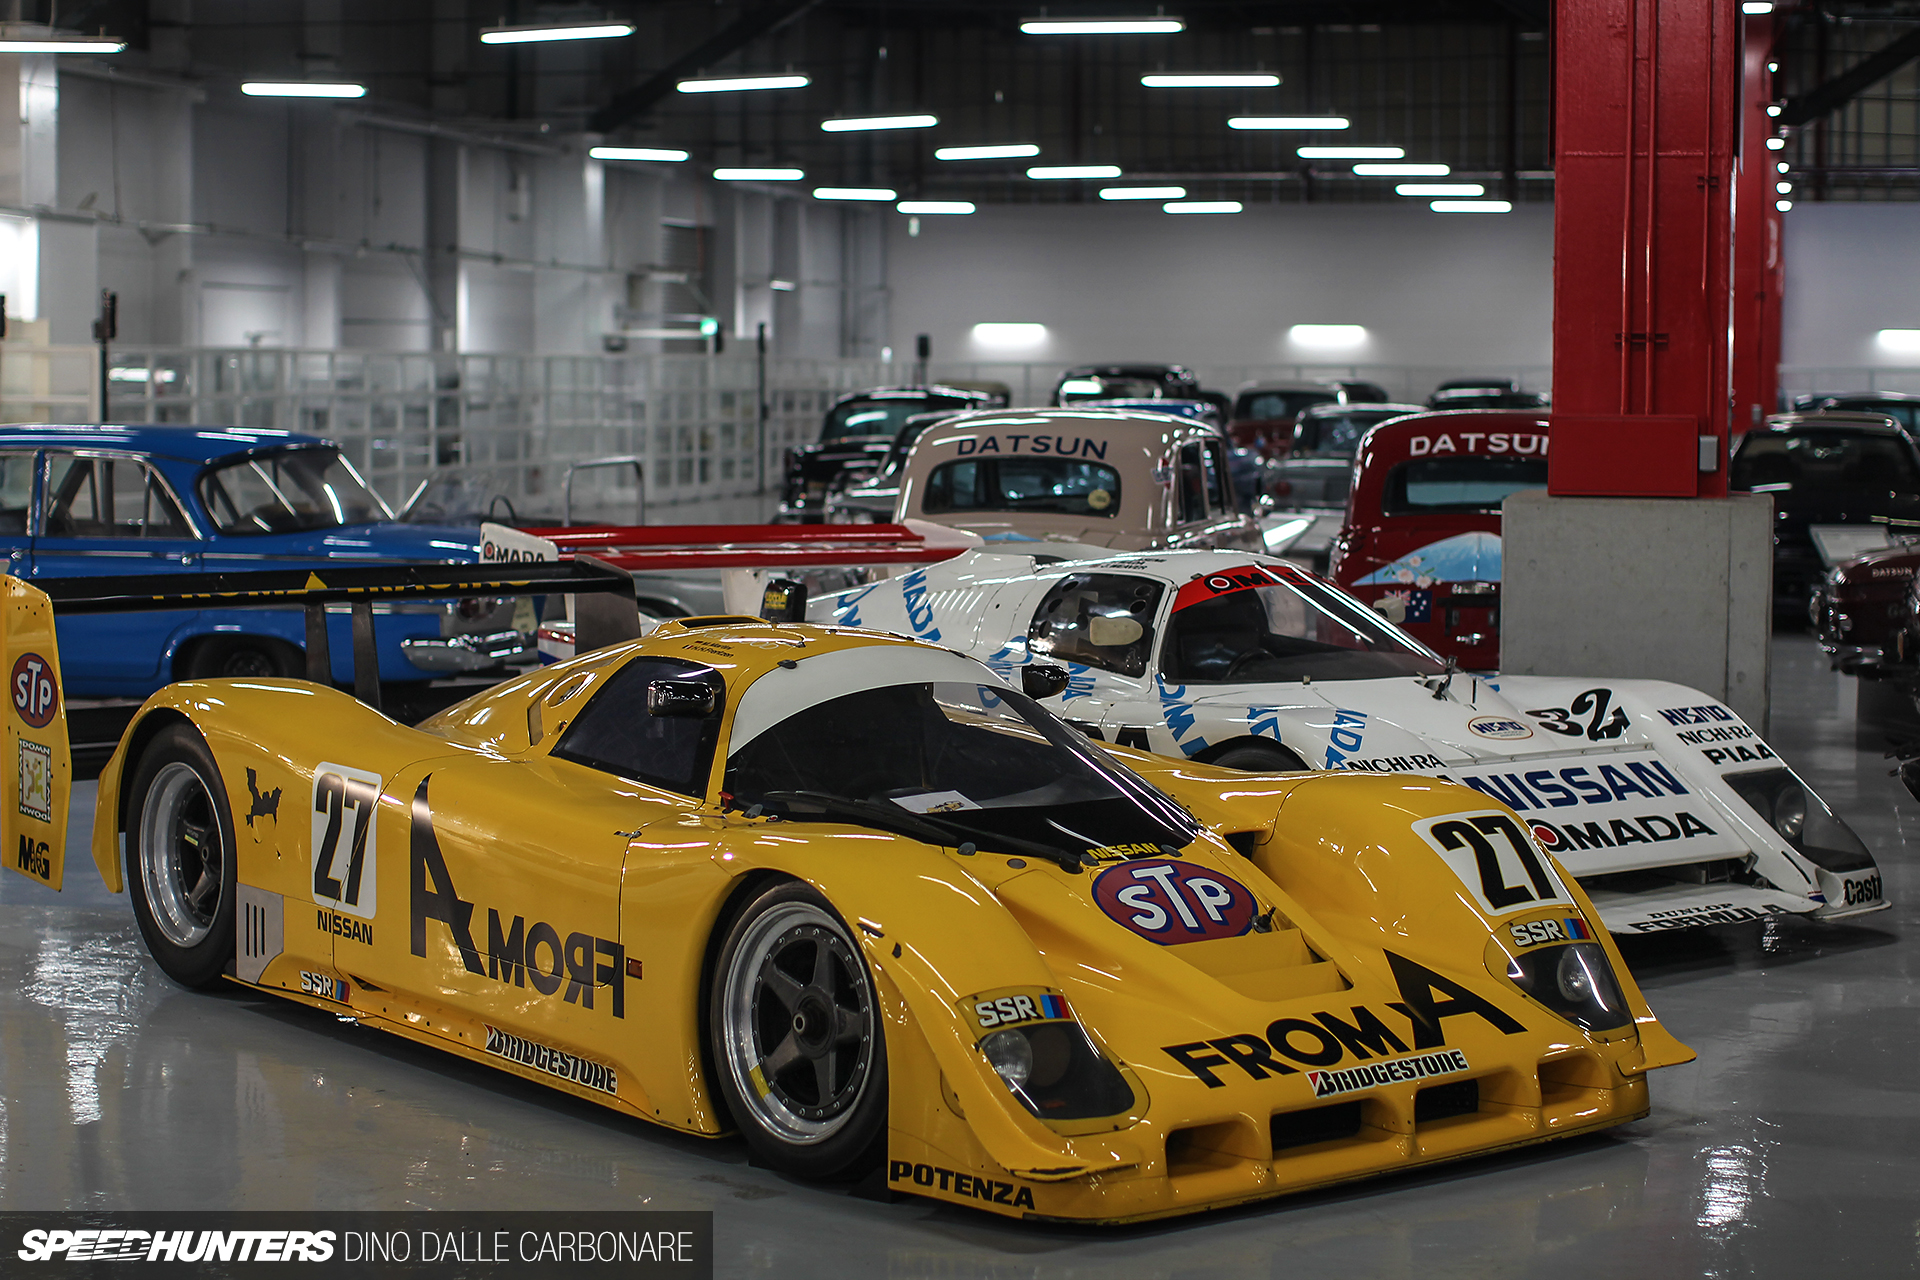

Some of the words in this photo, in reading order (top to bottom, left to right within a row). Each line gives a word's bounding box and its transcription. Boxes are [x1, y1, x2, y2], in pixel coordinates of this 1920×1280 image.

[957, 436, 1108, 460] DATSUN
[1872, 567, 1914, 579] DATSUN
[16, 660, 52, 717] STP
[1472, 721, 1526, 735] NISMO
[1525, 688, 1631, 742] 32
[1657, 705, 1734, 727] NISMO
[1701, 743, 1777, 765] PIAA
[1461, 760, 1690, 811] NISSAN
[315, 772, 378, 908] 27
[1525, 811, 1718, 852] AMADA
[1086, 842, 1162, 860] NISSAN
[1430, 815, 1558, 911] 27
[1115, 864, 1237, 934] STP
[1647, 903, 1733, 918] DUNLOP
[317, 910, 373, 946] NISSAN
[1509, 918, 1569, 948] SSR
[1627, 904, 1794, 932] FORMULA
[299, 969, 334, 999] SSR
[974, 995, 1044, 1028] SSR
[485, 1023, 617, 1095] BRIDGESTONE
[1307, 1050, 1468, 1097] BRIDGESTONE
[889, 1159, 1036, 1211] POTENZA
